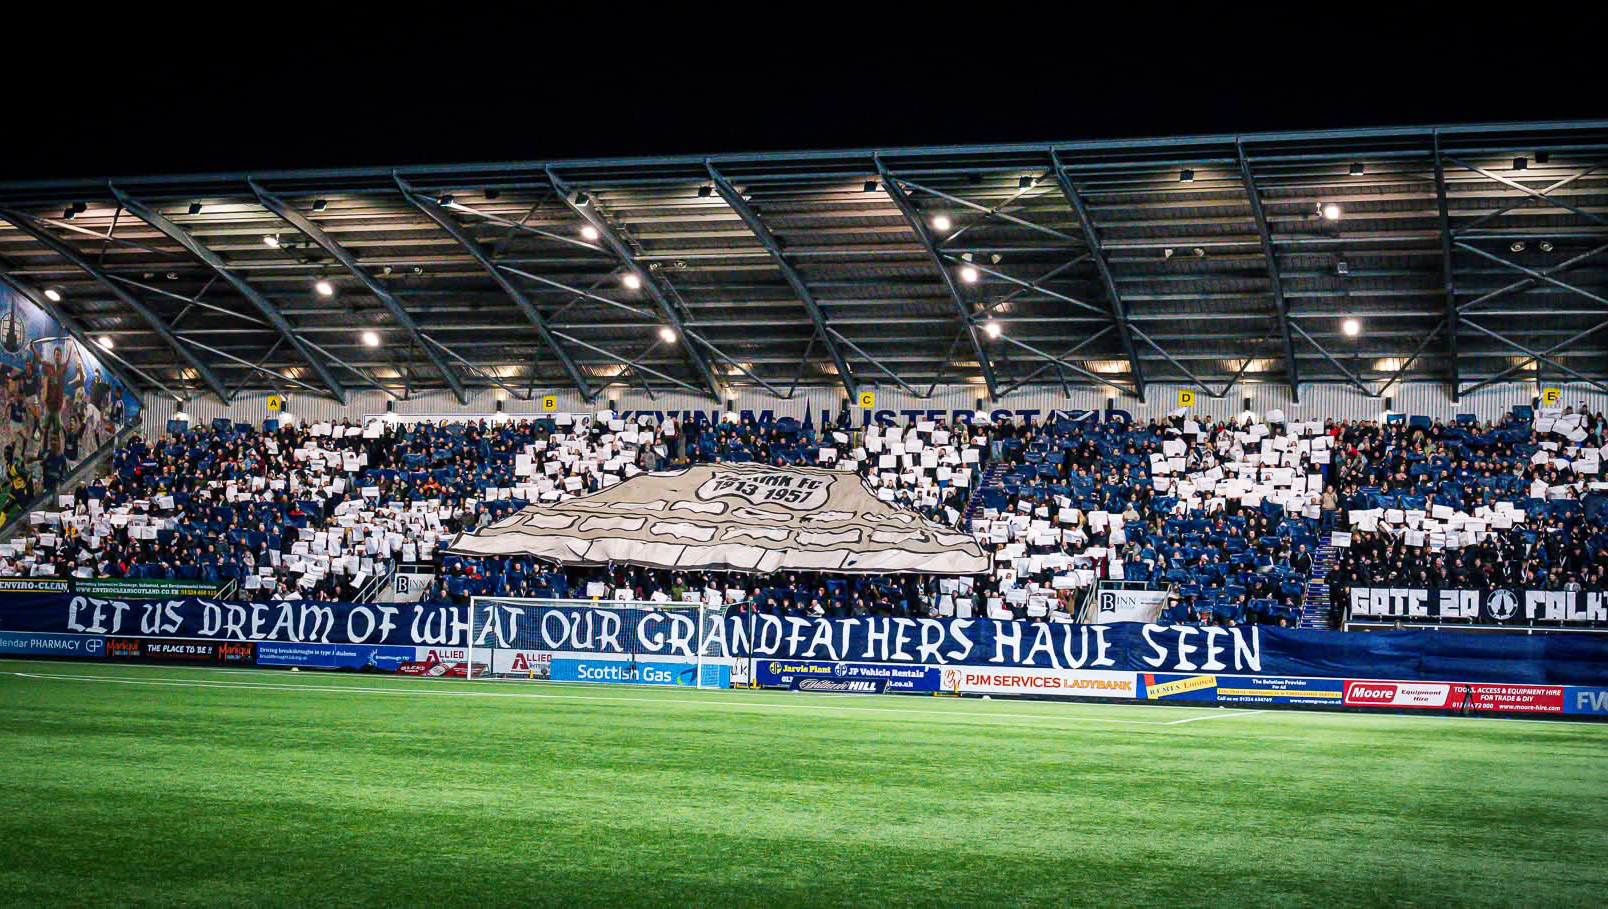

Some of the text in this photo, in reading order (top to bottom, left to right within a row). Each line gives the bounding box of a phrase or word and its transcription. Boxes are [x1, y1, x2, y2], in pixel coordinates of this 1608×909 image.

[863, 395, 872, 405] C
[1182, 393, 1191, 402] D
[1547, 391, 1556, 400] E
[545, 399, 553, 407] B
[798, 477, 823, 490] FC
[713, 480, 760, 496] 1913
[763, 488, 814, 503] 1957
[1103, 594, 1136, 610] BINN
[1351, 588, 1608, 621] GATE 20 FALK
[67, 596, 131, 634] LET
[141, 599, 186, 635] US
[197, 599, 336, 644] DREAM
[347, 603, 400, 644] OF
[410, 604, 525, 650] WHAT
[541, 607, 624, 653] OUR
[637, 611, 975, 665] GRANDFATHERS
[1141, 623, 1262, 672] SEEN
[30, 639, 80, 650] PHARMACY
[148, 644, 161, 653] THE
[162, 645, 186, 654] PLACE
[185, 645, 195, 654] TO
[197, 646, 207, 654] BE
[425, 649, 464, 664] ALLIED
[511, 652, 552, 670] ALLIED
[577, 664, 672, 682] Scottish Gas
[809, 665, 832, 673] Plant
[860, 667, 891, 677] Vehicle
[890, 669, 925, 678] Rentals
[848, 681, 877, 691] HILL
[965, 673, 992, 686] PJM
[993, 675, 1061, 688] SERVICES
[1063, 679, 1132, 691] LADYBANK
[1352, 687, 1394, 699] Moore
[1453, 686, 1476, 694] TOOS,
